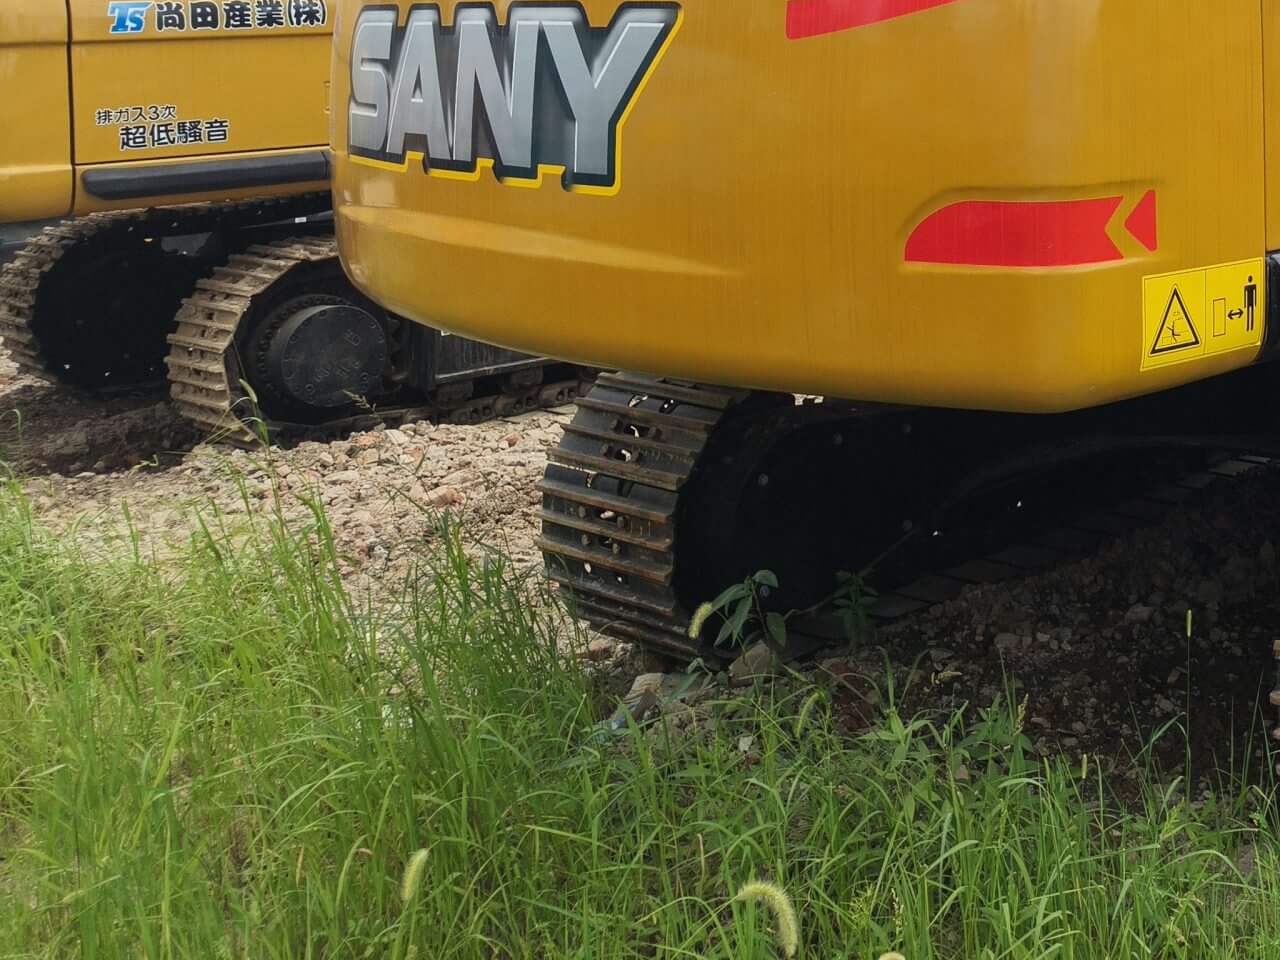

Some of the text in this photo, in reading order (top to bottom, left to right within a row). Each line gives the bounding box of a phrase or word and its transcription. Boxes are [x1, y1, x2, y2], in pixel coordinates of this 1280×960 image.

[349, 8, 672, 182] SANY
[96, 105, 177, 125] 排ガス3次
[119, 118, 230, 150] 超低騒音
